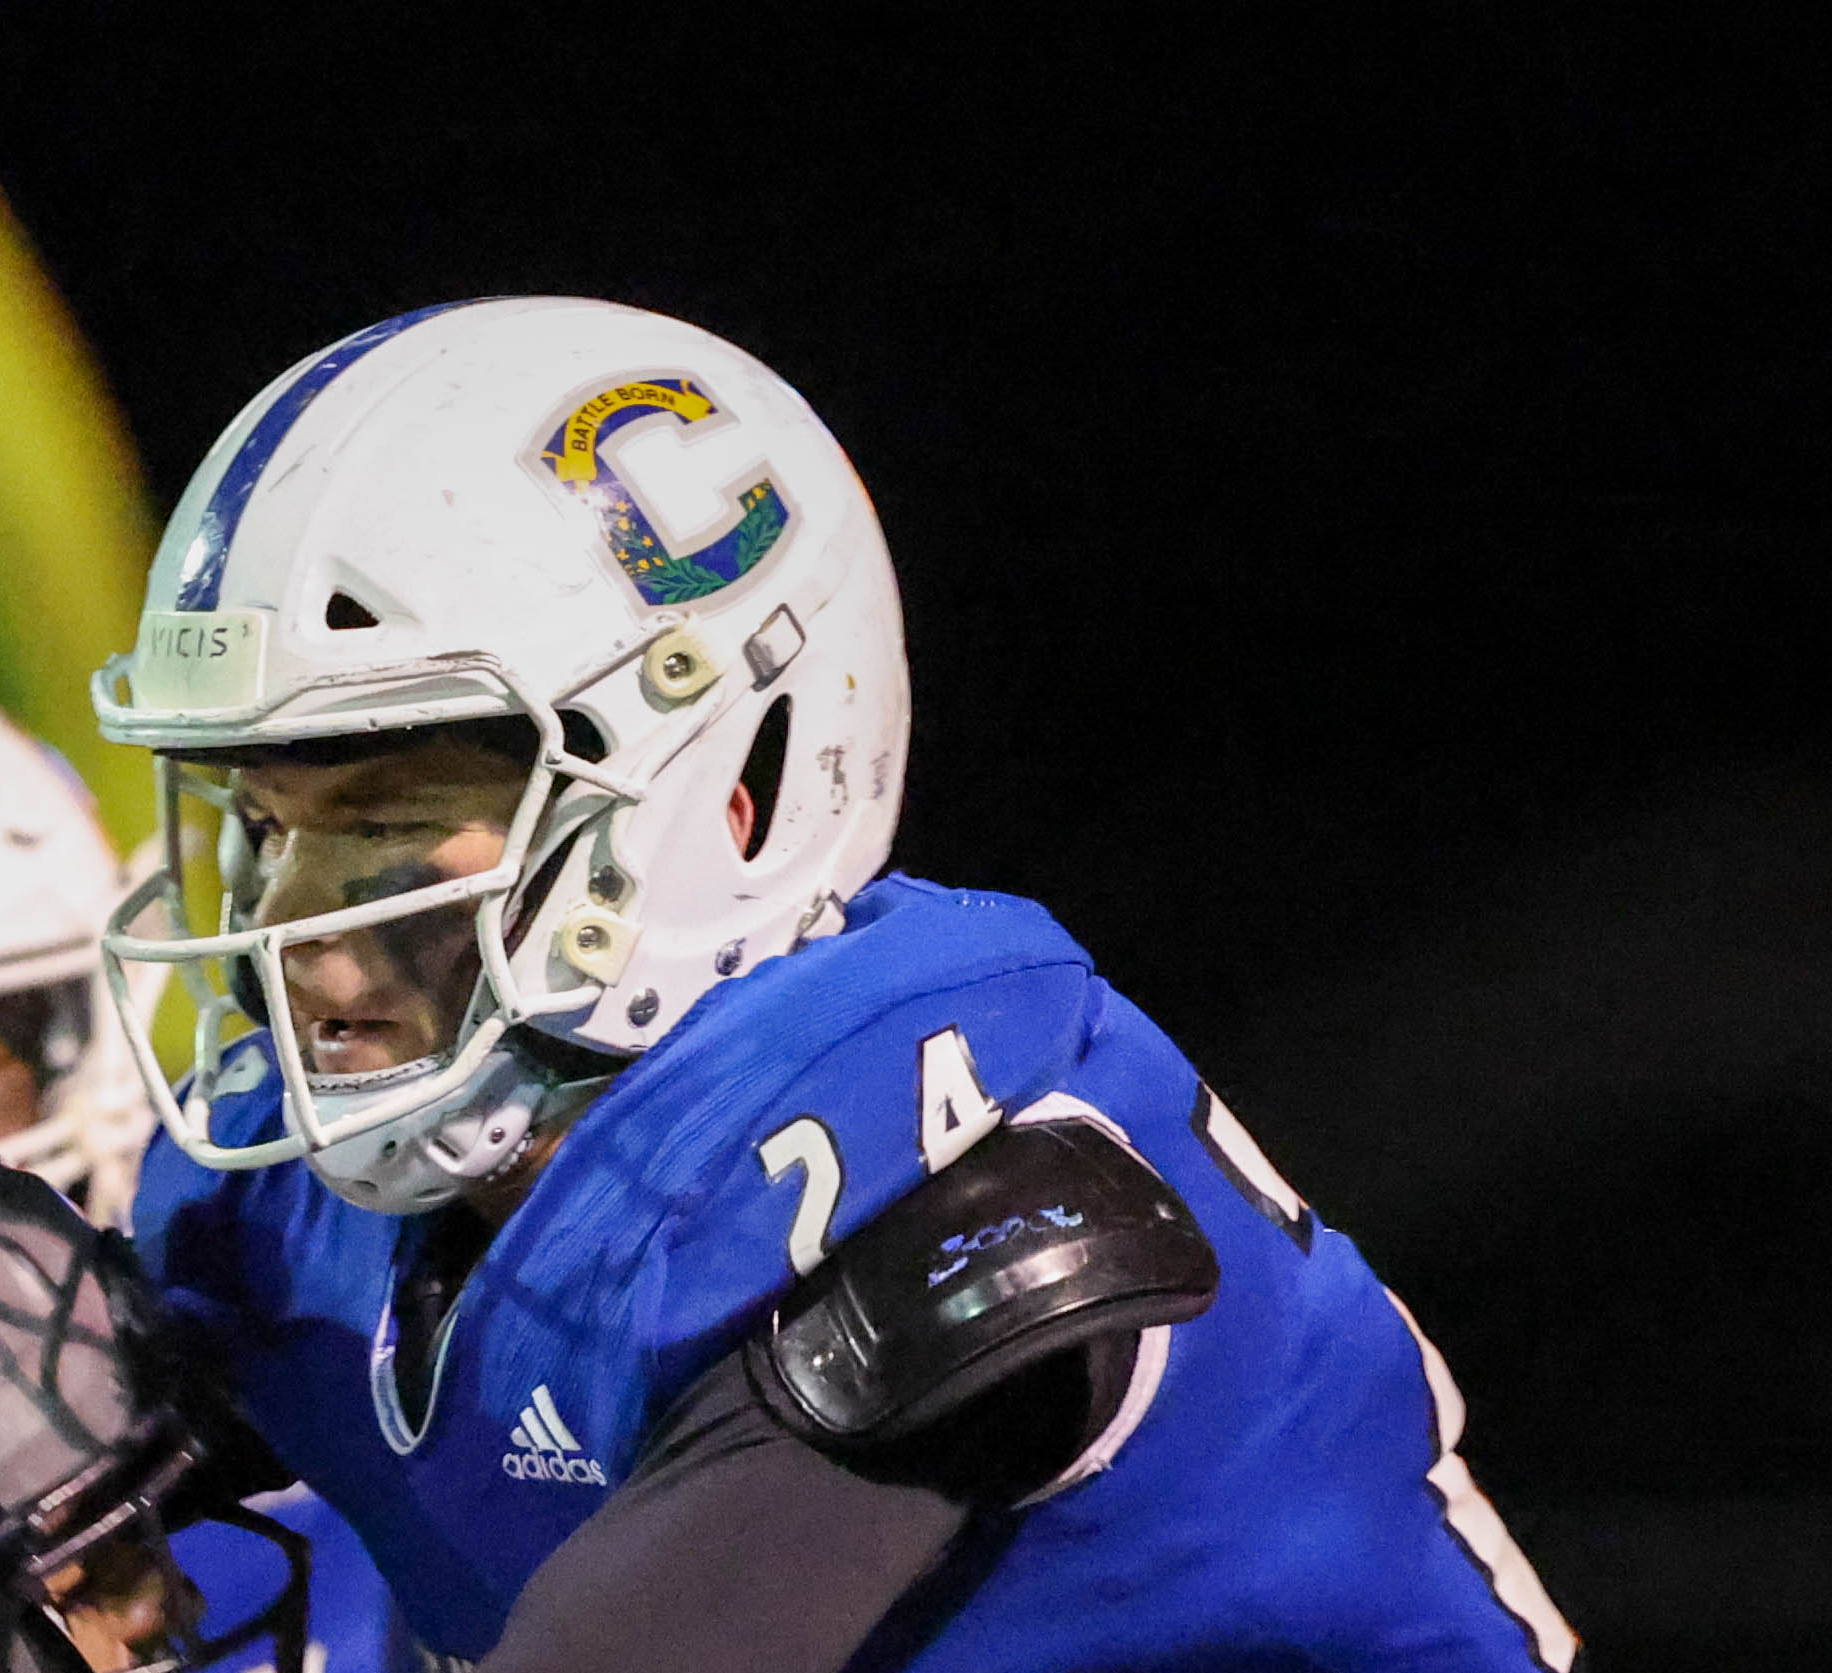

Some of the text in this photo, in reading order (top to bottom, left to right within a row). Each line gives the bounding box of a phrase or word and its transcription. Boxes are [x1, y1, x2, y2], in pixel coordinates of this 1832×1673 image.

[571, 386, 676, 452] BATTLE BORN
[517, 367, 804, 618] C
[502, 1446, 608, 1487] adidas
